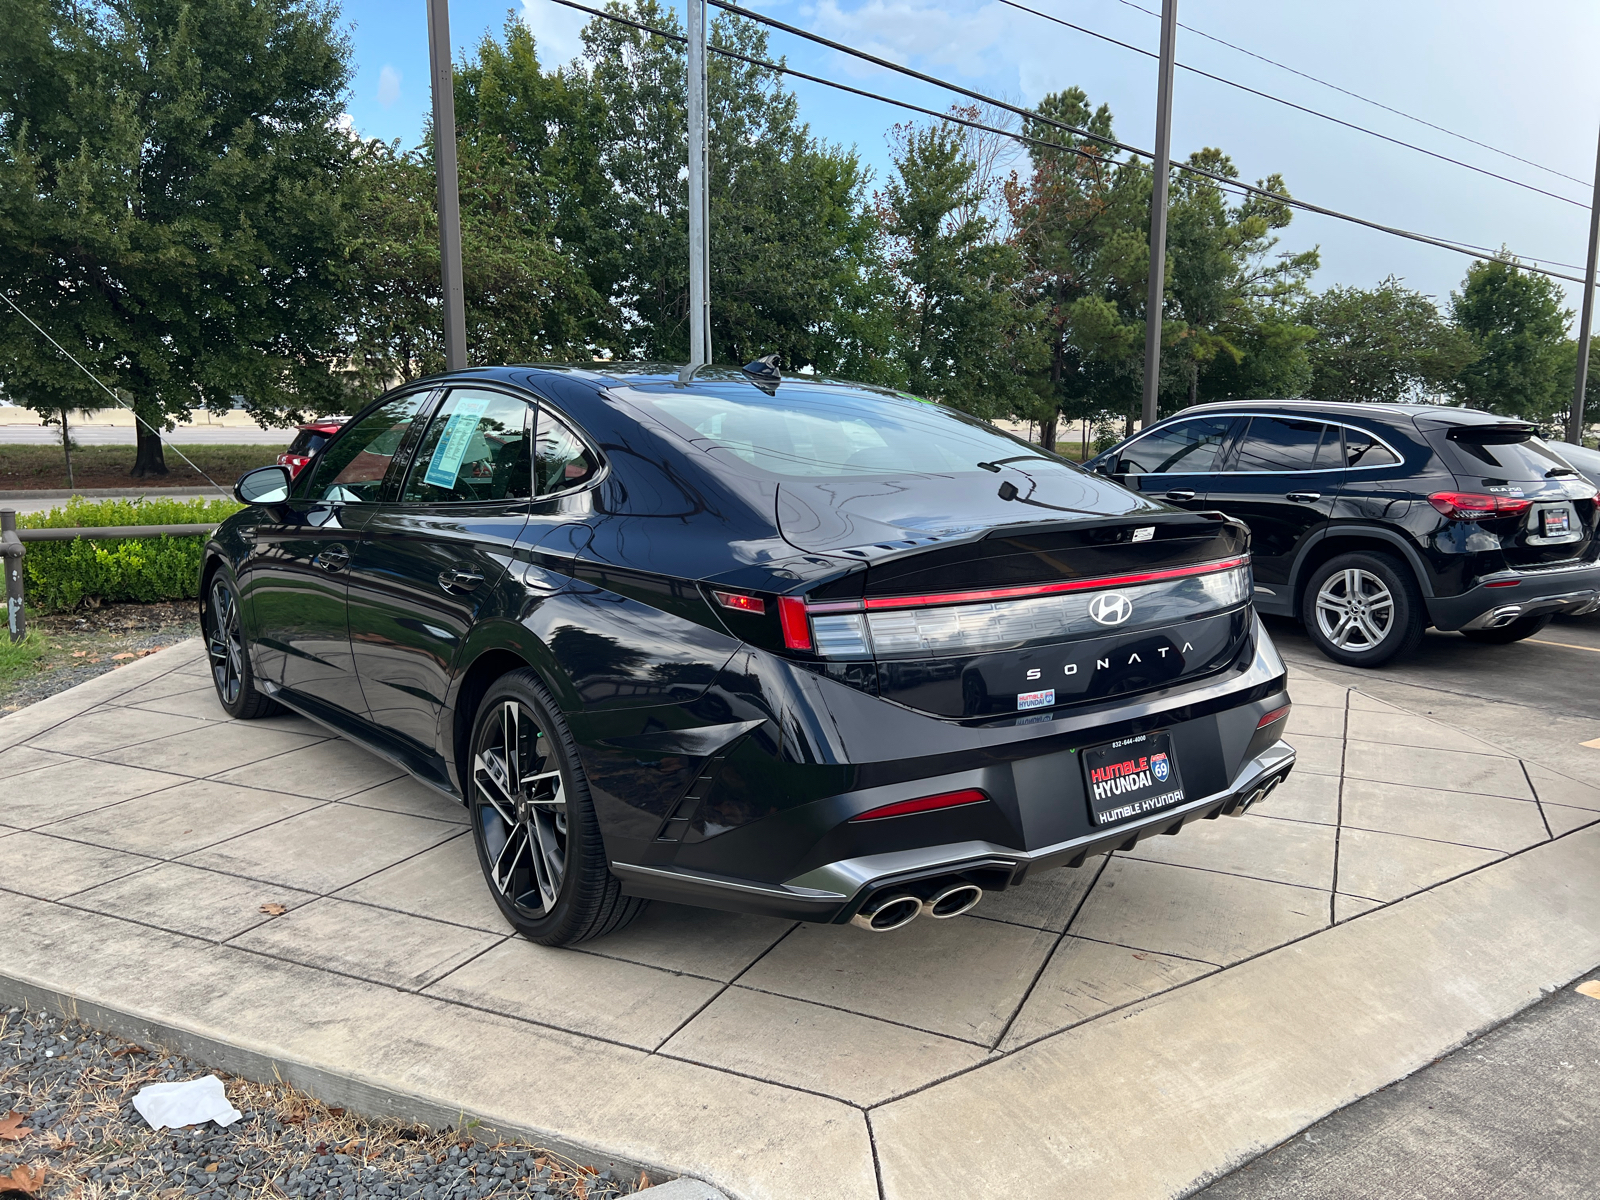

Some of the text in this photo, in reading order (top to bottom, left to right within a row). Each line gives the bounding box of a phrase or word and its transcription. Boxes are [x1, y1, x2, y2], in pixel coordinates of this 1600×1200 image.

[1026, 642, 1194, 680] SONATA
[1018, 693, 1044, 702] HUMBLE
[1018, 699, 1045, 708] HYUNDAI
[1091, 757, 1149, 783] HUMBLE
[1155, 762, 1167, 777] 69
[1093, 770, 1152, 800] HYUNDAI
[1099, 790, 1184, 824] HUMBLE HYUNDAI
